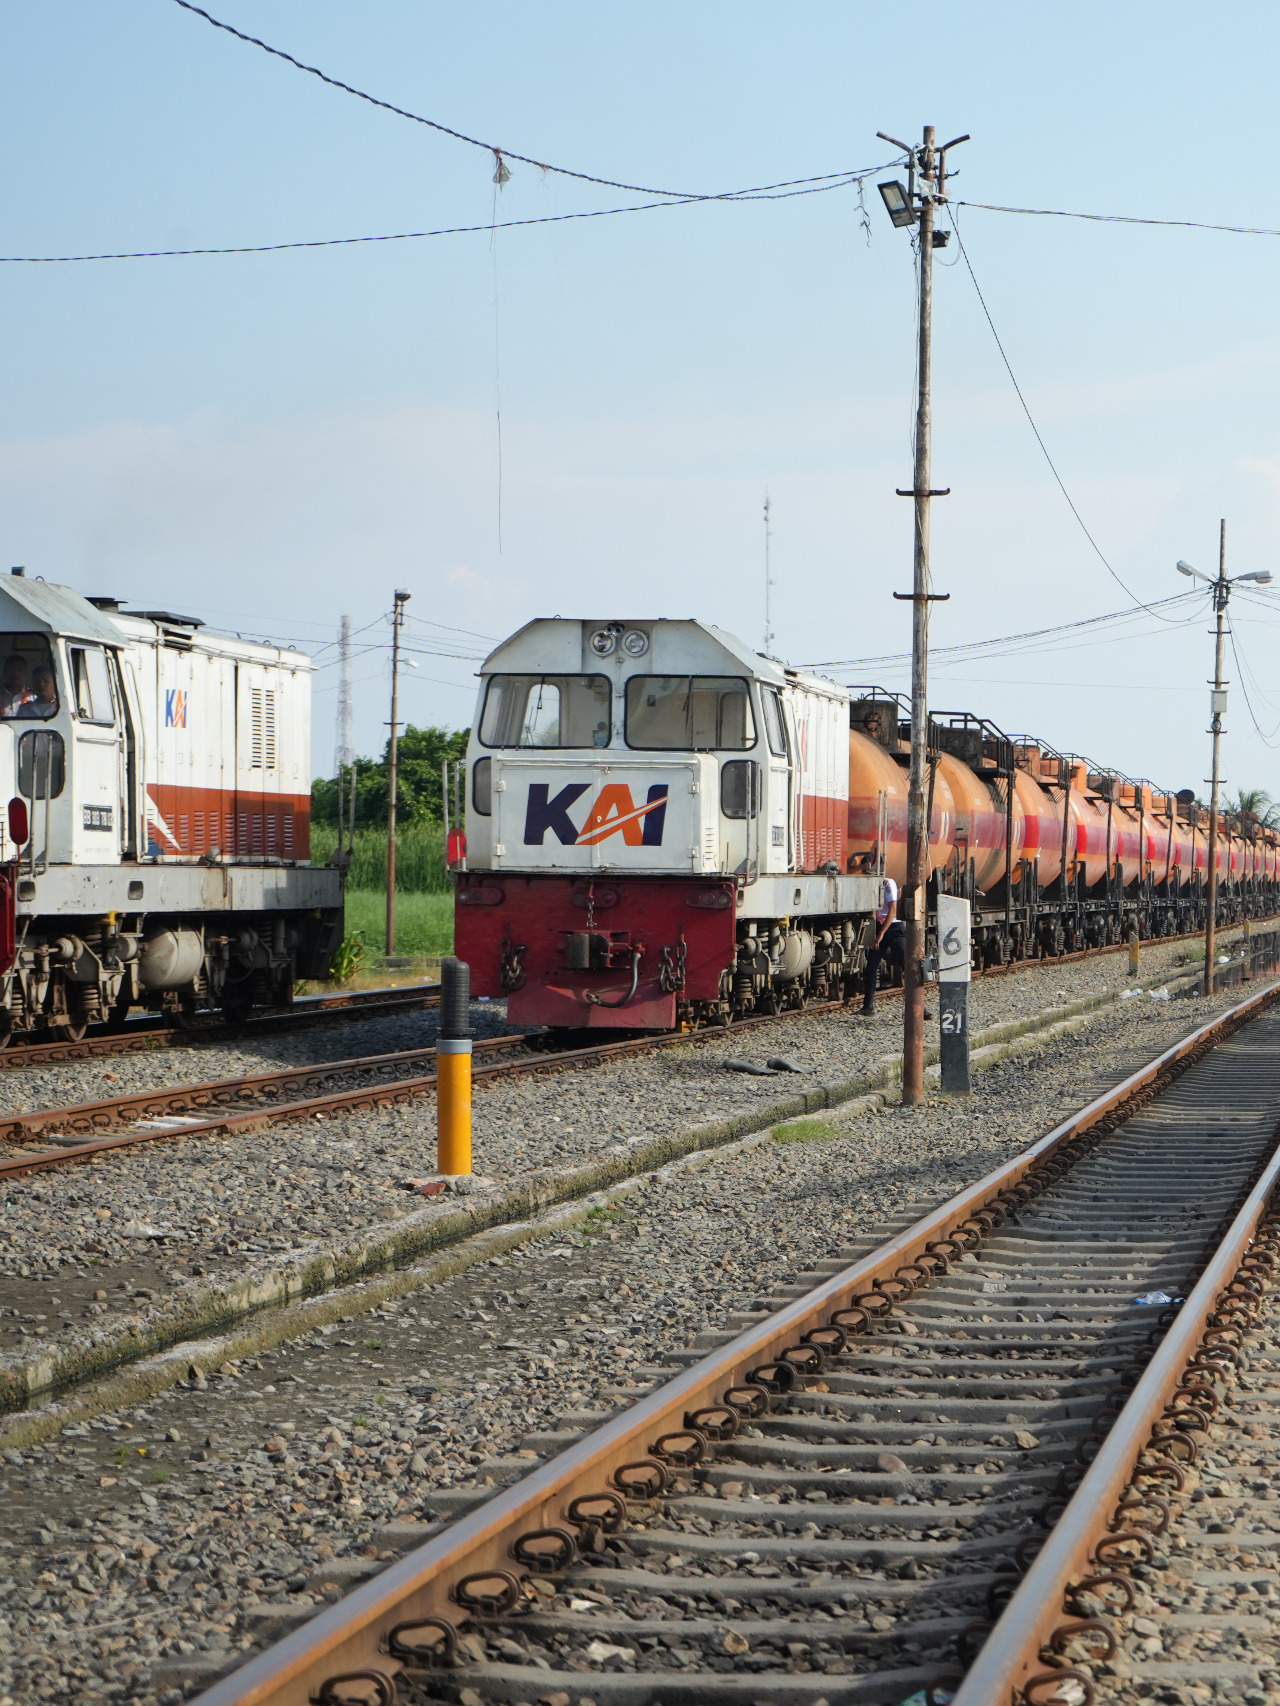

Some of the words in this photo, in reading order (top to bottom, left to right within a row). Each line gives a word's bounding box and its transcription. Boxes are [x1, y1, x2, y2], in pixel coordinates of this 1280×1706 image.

[165, 688, 188, 729] KAI
[523, 783, 669, 847] KAI
[942, 926, 962, 956] 6
[942, 1013, 962, 1033] 21
